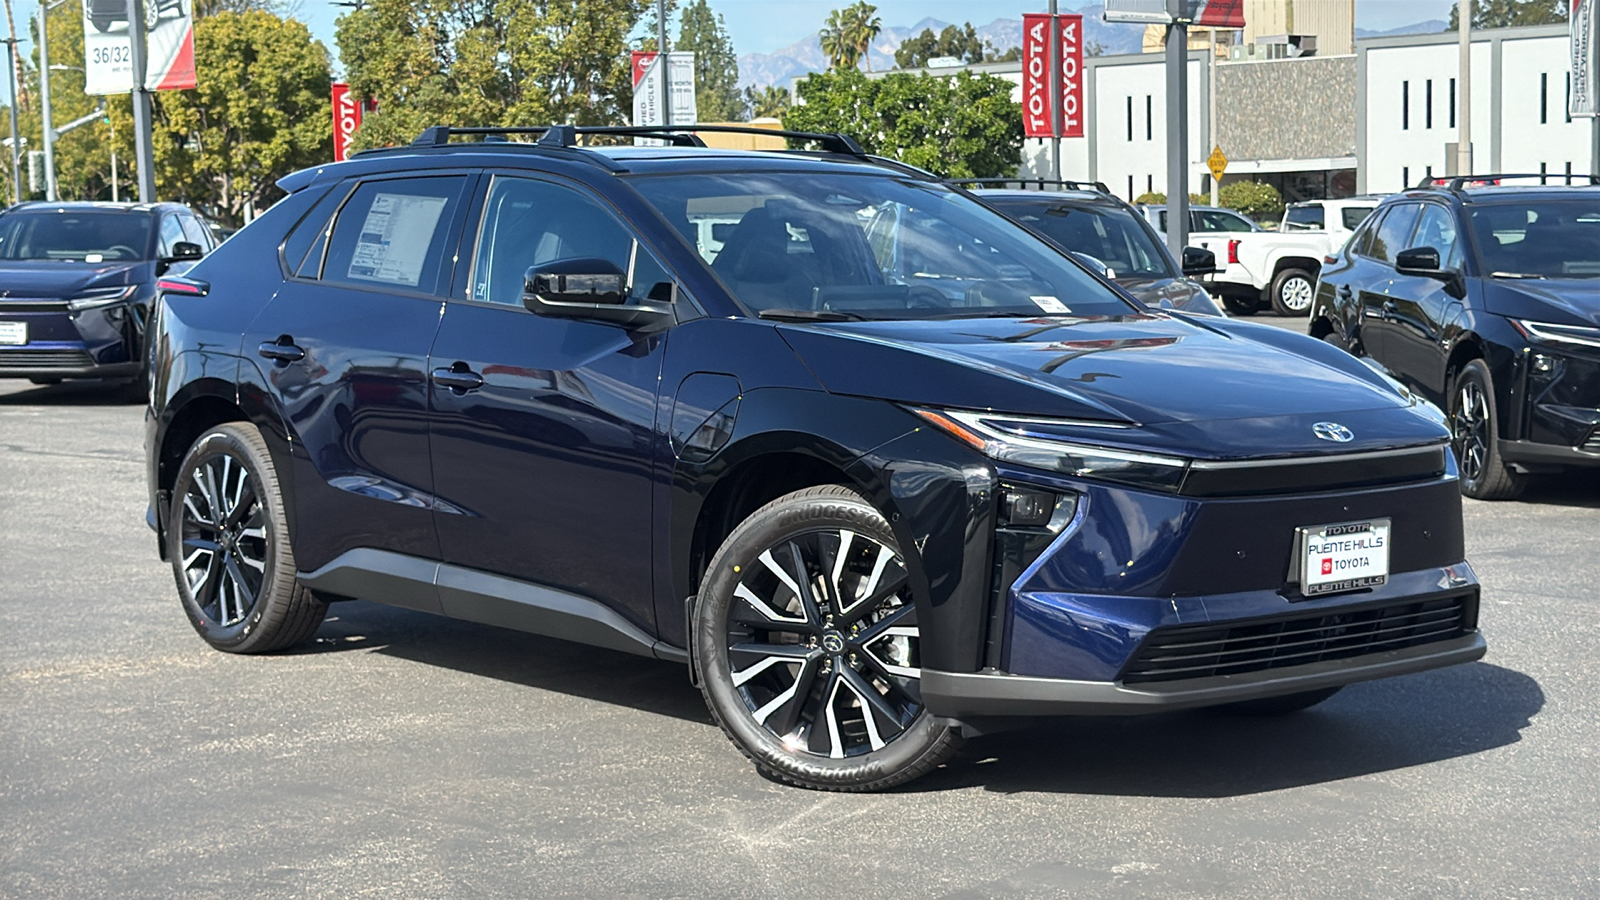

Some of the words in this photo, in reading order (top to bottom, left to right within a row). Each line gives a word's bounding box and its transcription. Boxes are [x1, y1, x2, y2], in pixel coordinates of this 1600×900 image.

[93, 46, 130, 64] 36/32
[1029, 22, 1044, 132] TOYOTA
[1063, 22, 1077, 131] TOYOTA
[648, 77, 656, 123] VEHICLES
[340, 91, 355, 161] OYOTA
[1326, 524, 1370, 535] TOYOTA
[1308, 541, 1351, 555] PUENTE
[1353, 537, 1383, 550] HILLS
[1334, 557, 1370, 570] TOYOTA
[1309, 580, 1352, 594] PUENTE
[1353, 577, 1384, 589] HILLS
